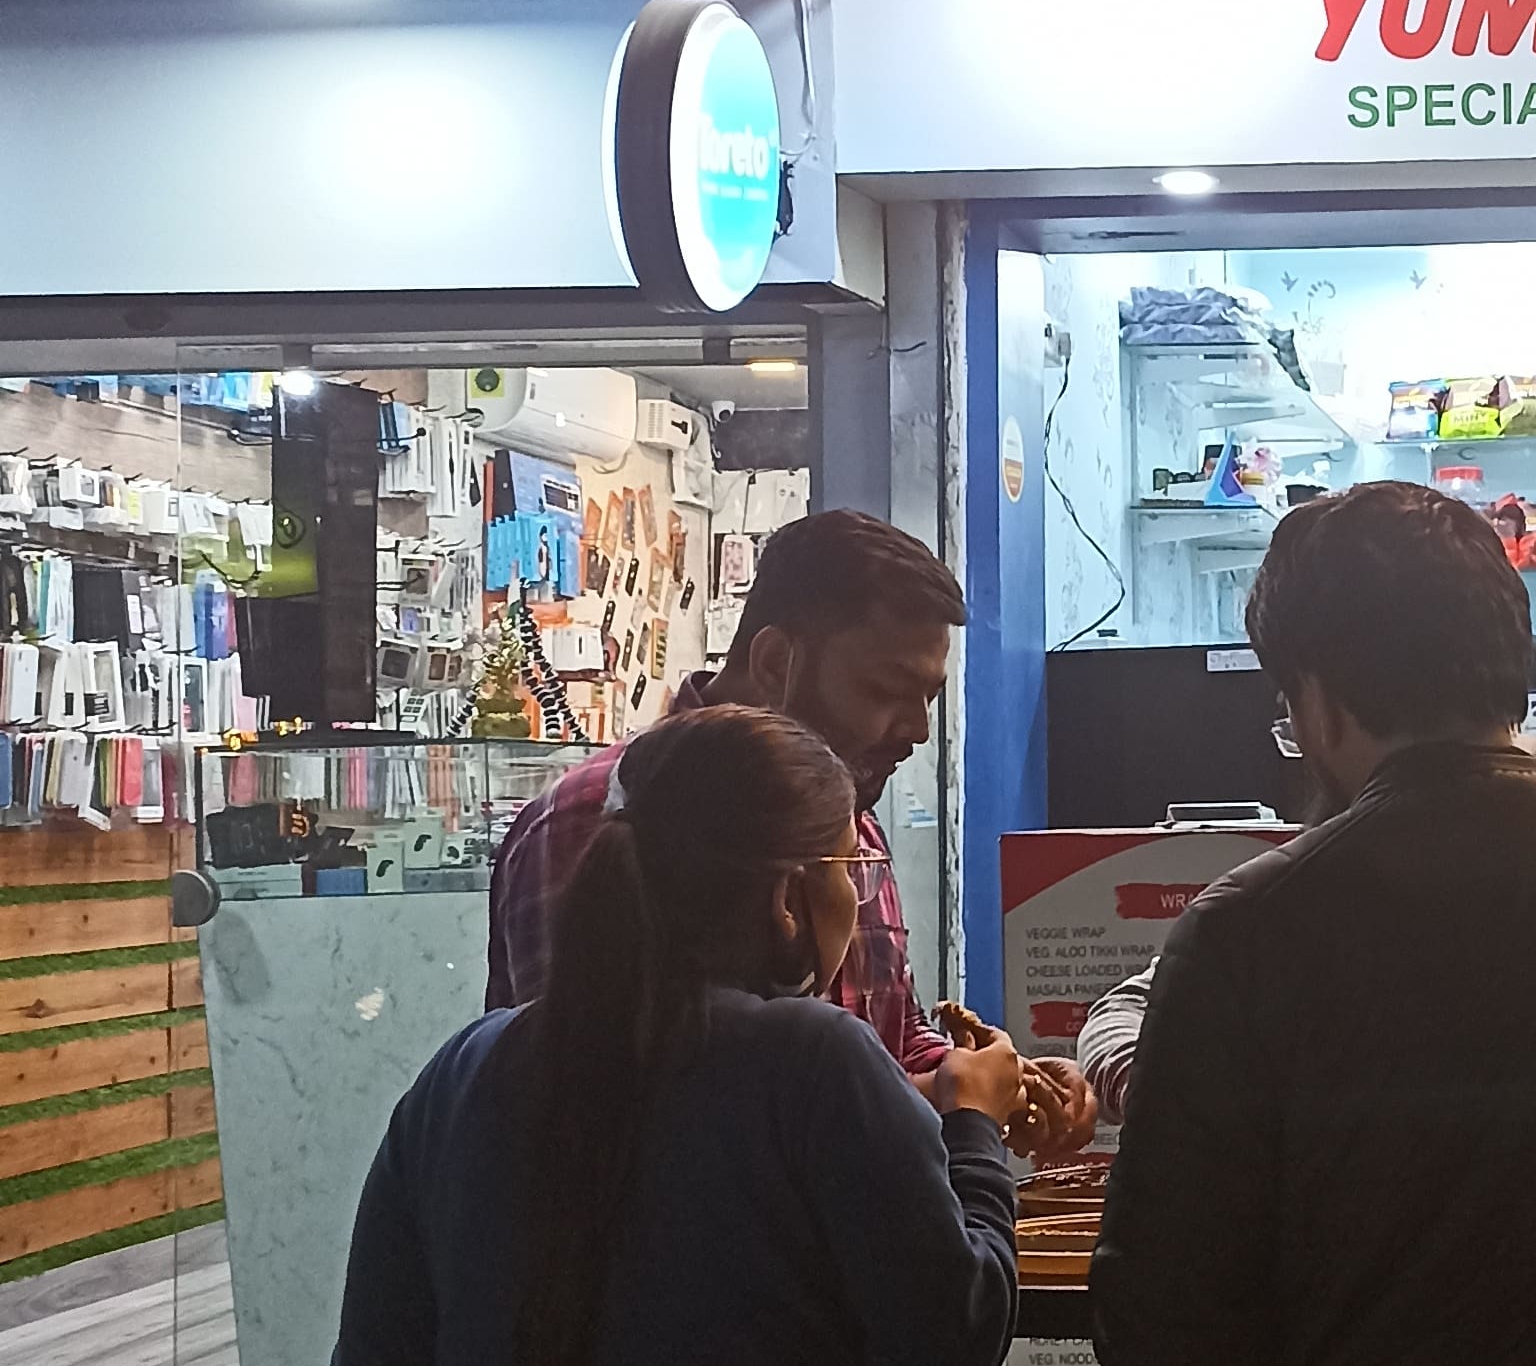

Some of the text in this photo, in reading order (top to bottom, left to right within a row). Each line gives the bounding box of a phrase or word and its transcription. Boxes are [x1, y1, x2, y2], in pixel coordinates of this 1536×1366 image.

[1026, 926, 1106, 939] VEGGIE WRAP
[1055, 946, 1086, 958] ALOO
[1120, 945, 1155, 956] WRAP
[1026, 965, 1071, 977] CHEESE
[1075, 964, 1122, 977] LOADED
[1027, 984, 1073, 996] MASALA
